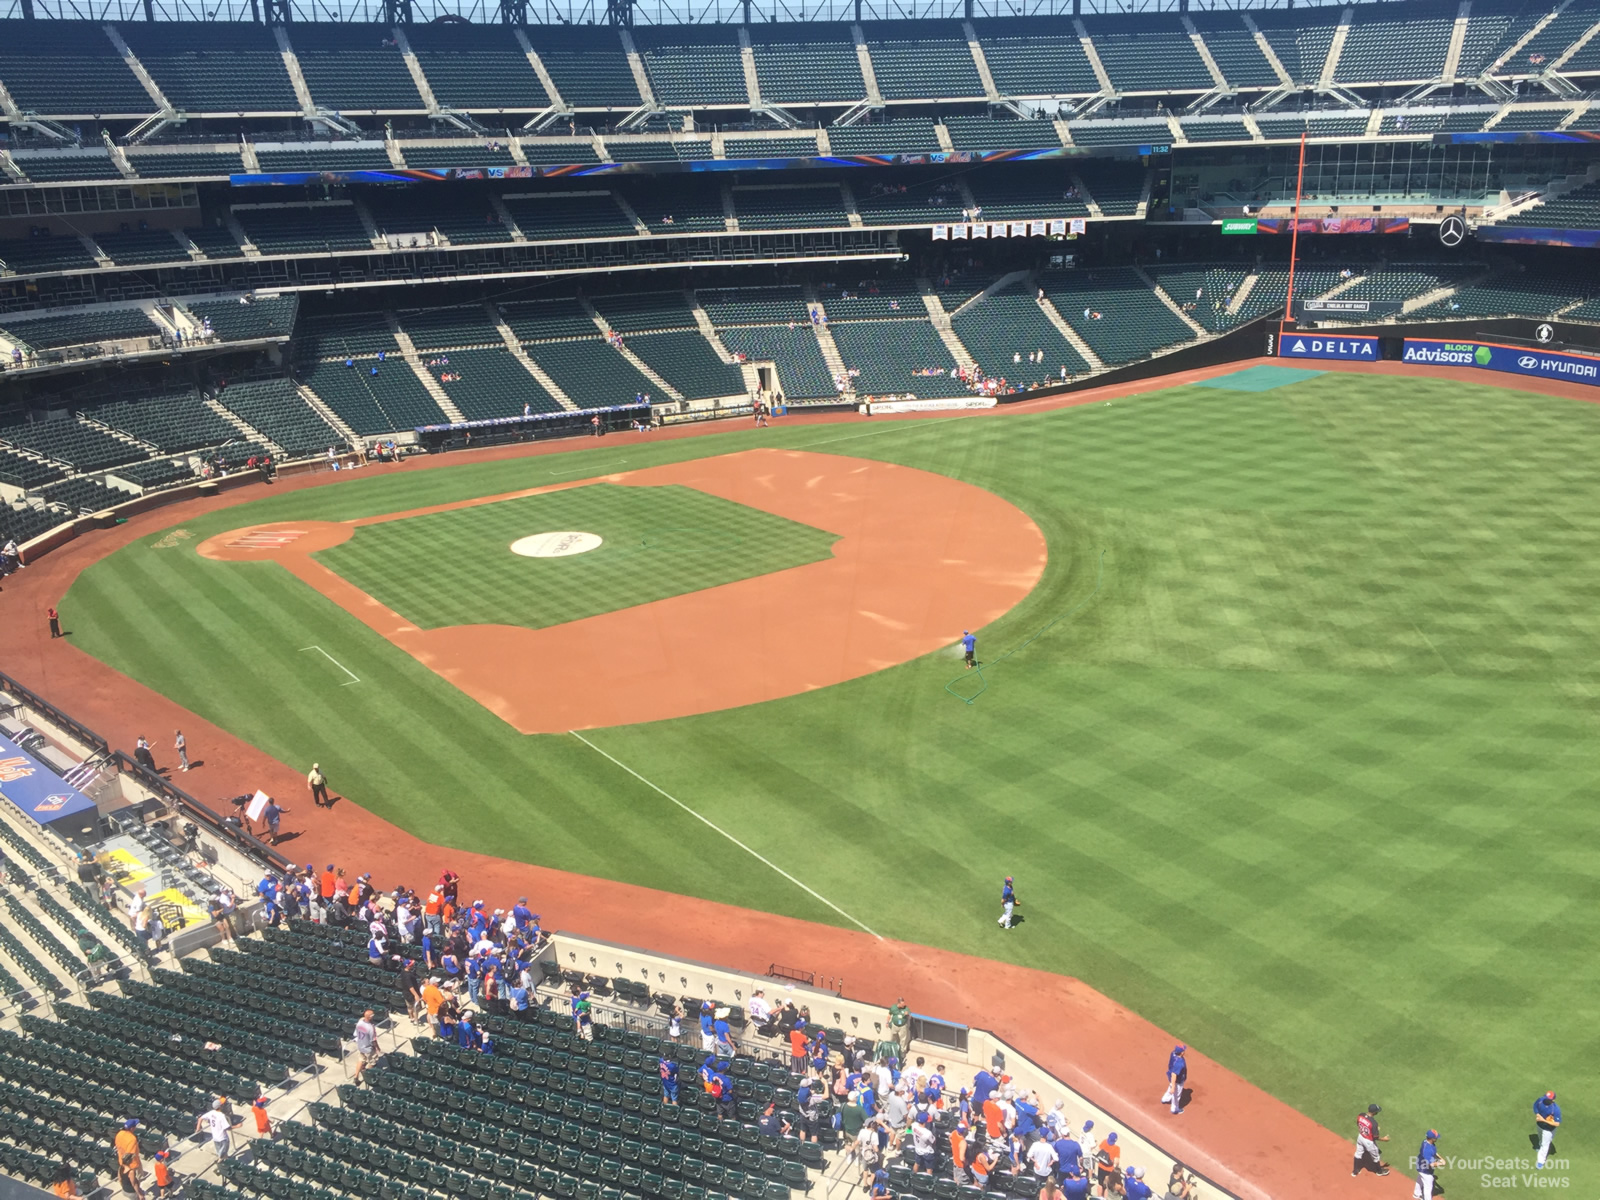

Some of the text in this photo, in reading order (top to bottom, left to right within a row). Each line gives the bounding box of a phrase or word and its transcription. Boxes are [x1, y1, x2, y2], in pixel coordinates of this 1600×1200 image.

[1322, 223, 1340, 231] VS
[1311, 340, 1373, 355] DELTA
[1444, 344, 1473, 352] BLOCK
[1404, 347, 1473, 364] Advisors
[1541, 359, 1597, 378] HYUNDAI
